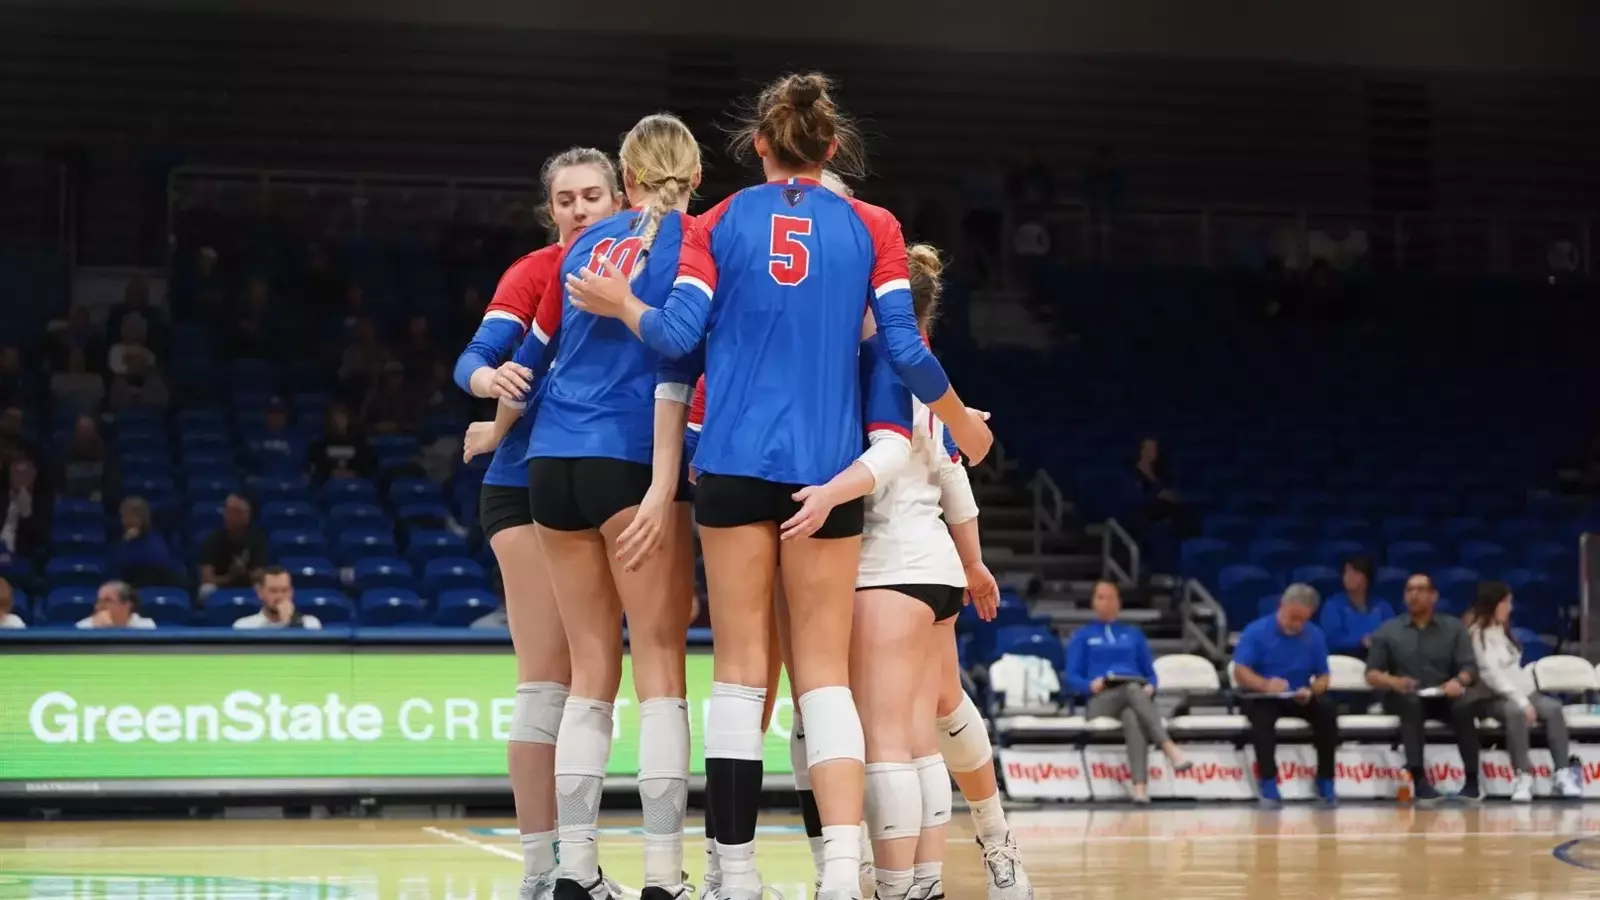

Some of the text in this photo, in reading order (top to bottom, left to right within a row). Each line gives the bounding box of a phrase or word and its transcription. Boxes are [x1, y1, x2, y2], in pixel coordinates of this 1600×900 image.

[584, 236, 646, 284] 10
[769, 213, 812, 287] 5
[29, 690, 384, 744] GreenState
[401, 697, 631, 742] CRET
